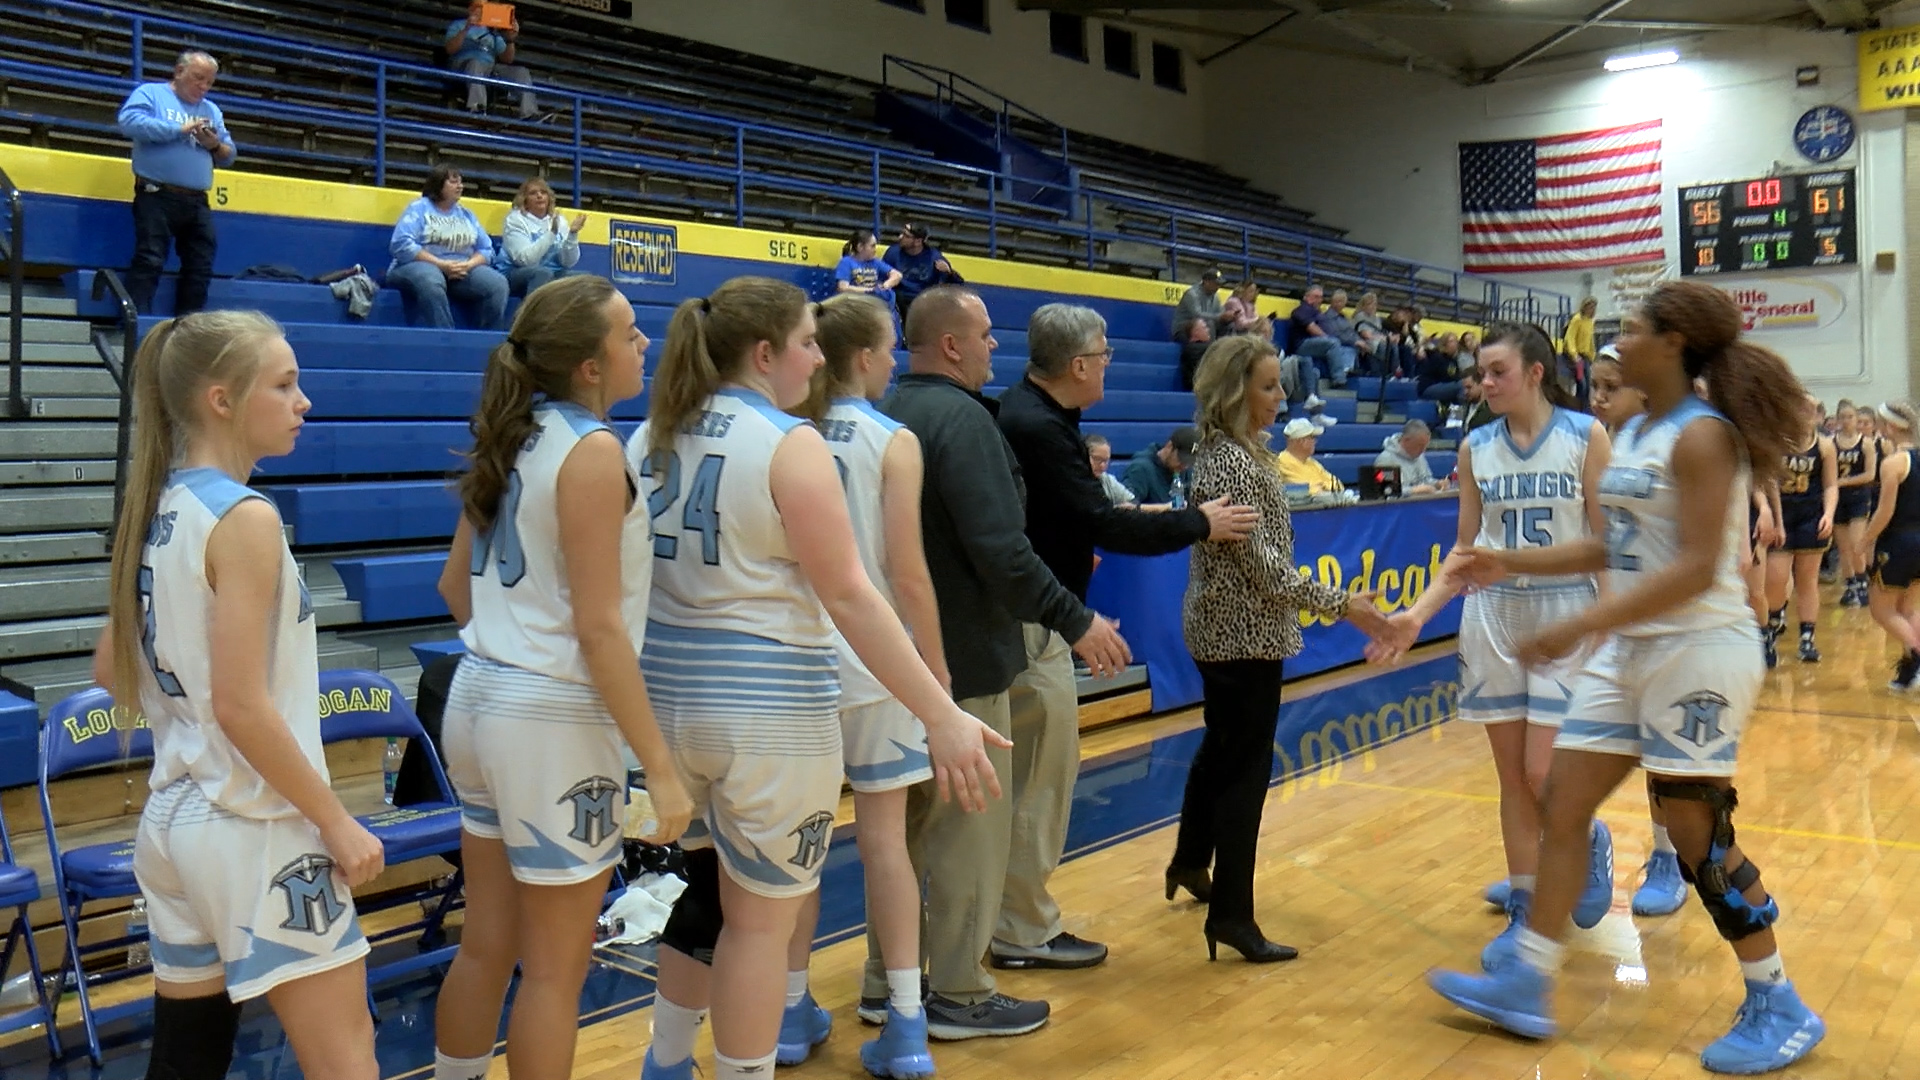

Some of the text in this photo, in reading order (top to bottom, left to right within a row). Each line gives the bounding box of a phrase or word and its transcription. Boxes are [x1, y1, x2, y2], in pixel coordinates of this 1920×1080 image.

[1885, 83, 1920, 100] WI
[216, 187, 228, 205] 5
[1813, 188, 1845, 214] 61
[1693, 201, 1721, 226] 56
[1774, 208, 1786, 227] 4
[615, 228, 673, 276] RESERVED
[769, 239, 809, 261] SEC 5
[1733, 287, 1768, 304] ittle
[75, 466, 83, 480] D
[640, 450, 725, 566] 24
[1501, 506, 1553, 550] 15
[319, 687, 391, 719] OGAN
